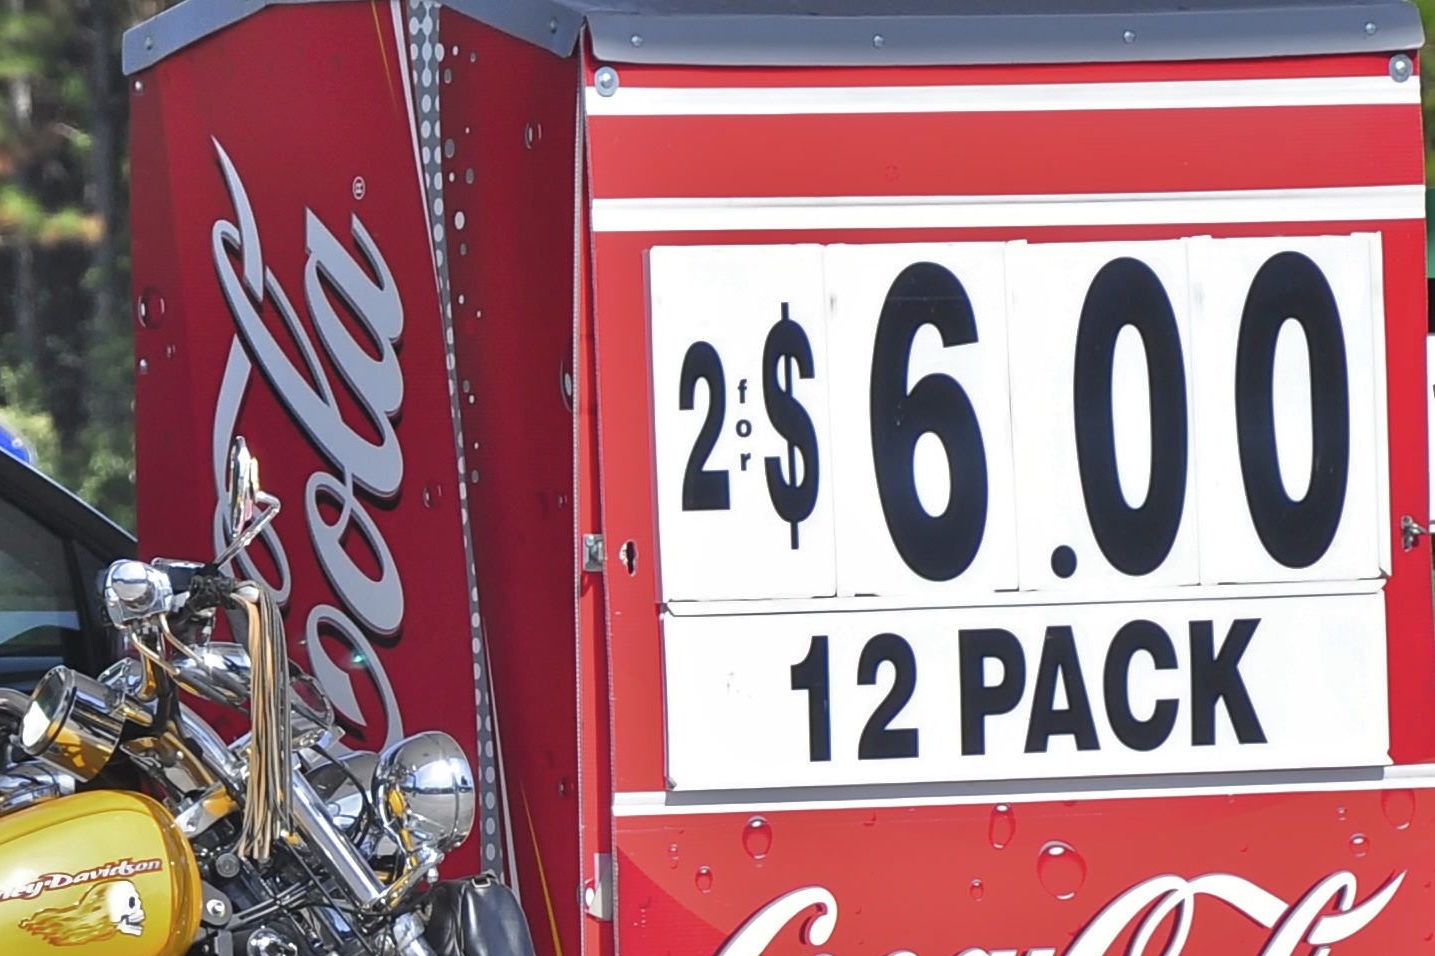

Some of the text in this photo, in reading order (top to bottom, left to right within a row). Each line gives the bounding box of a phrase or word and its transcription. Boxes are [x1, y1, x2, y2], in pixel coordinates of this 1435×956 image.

[678, 341, 732, 512] 2
[790, 617, 1268, 763] 12 PACK
